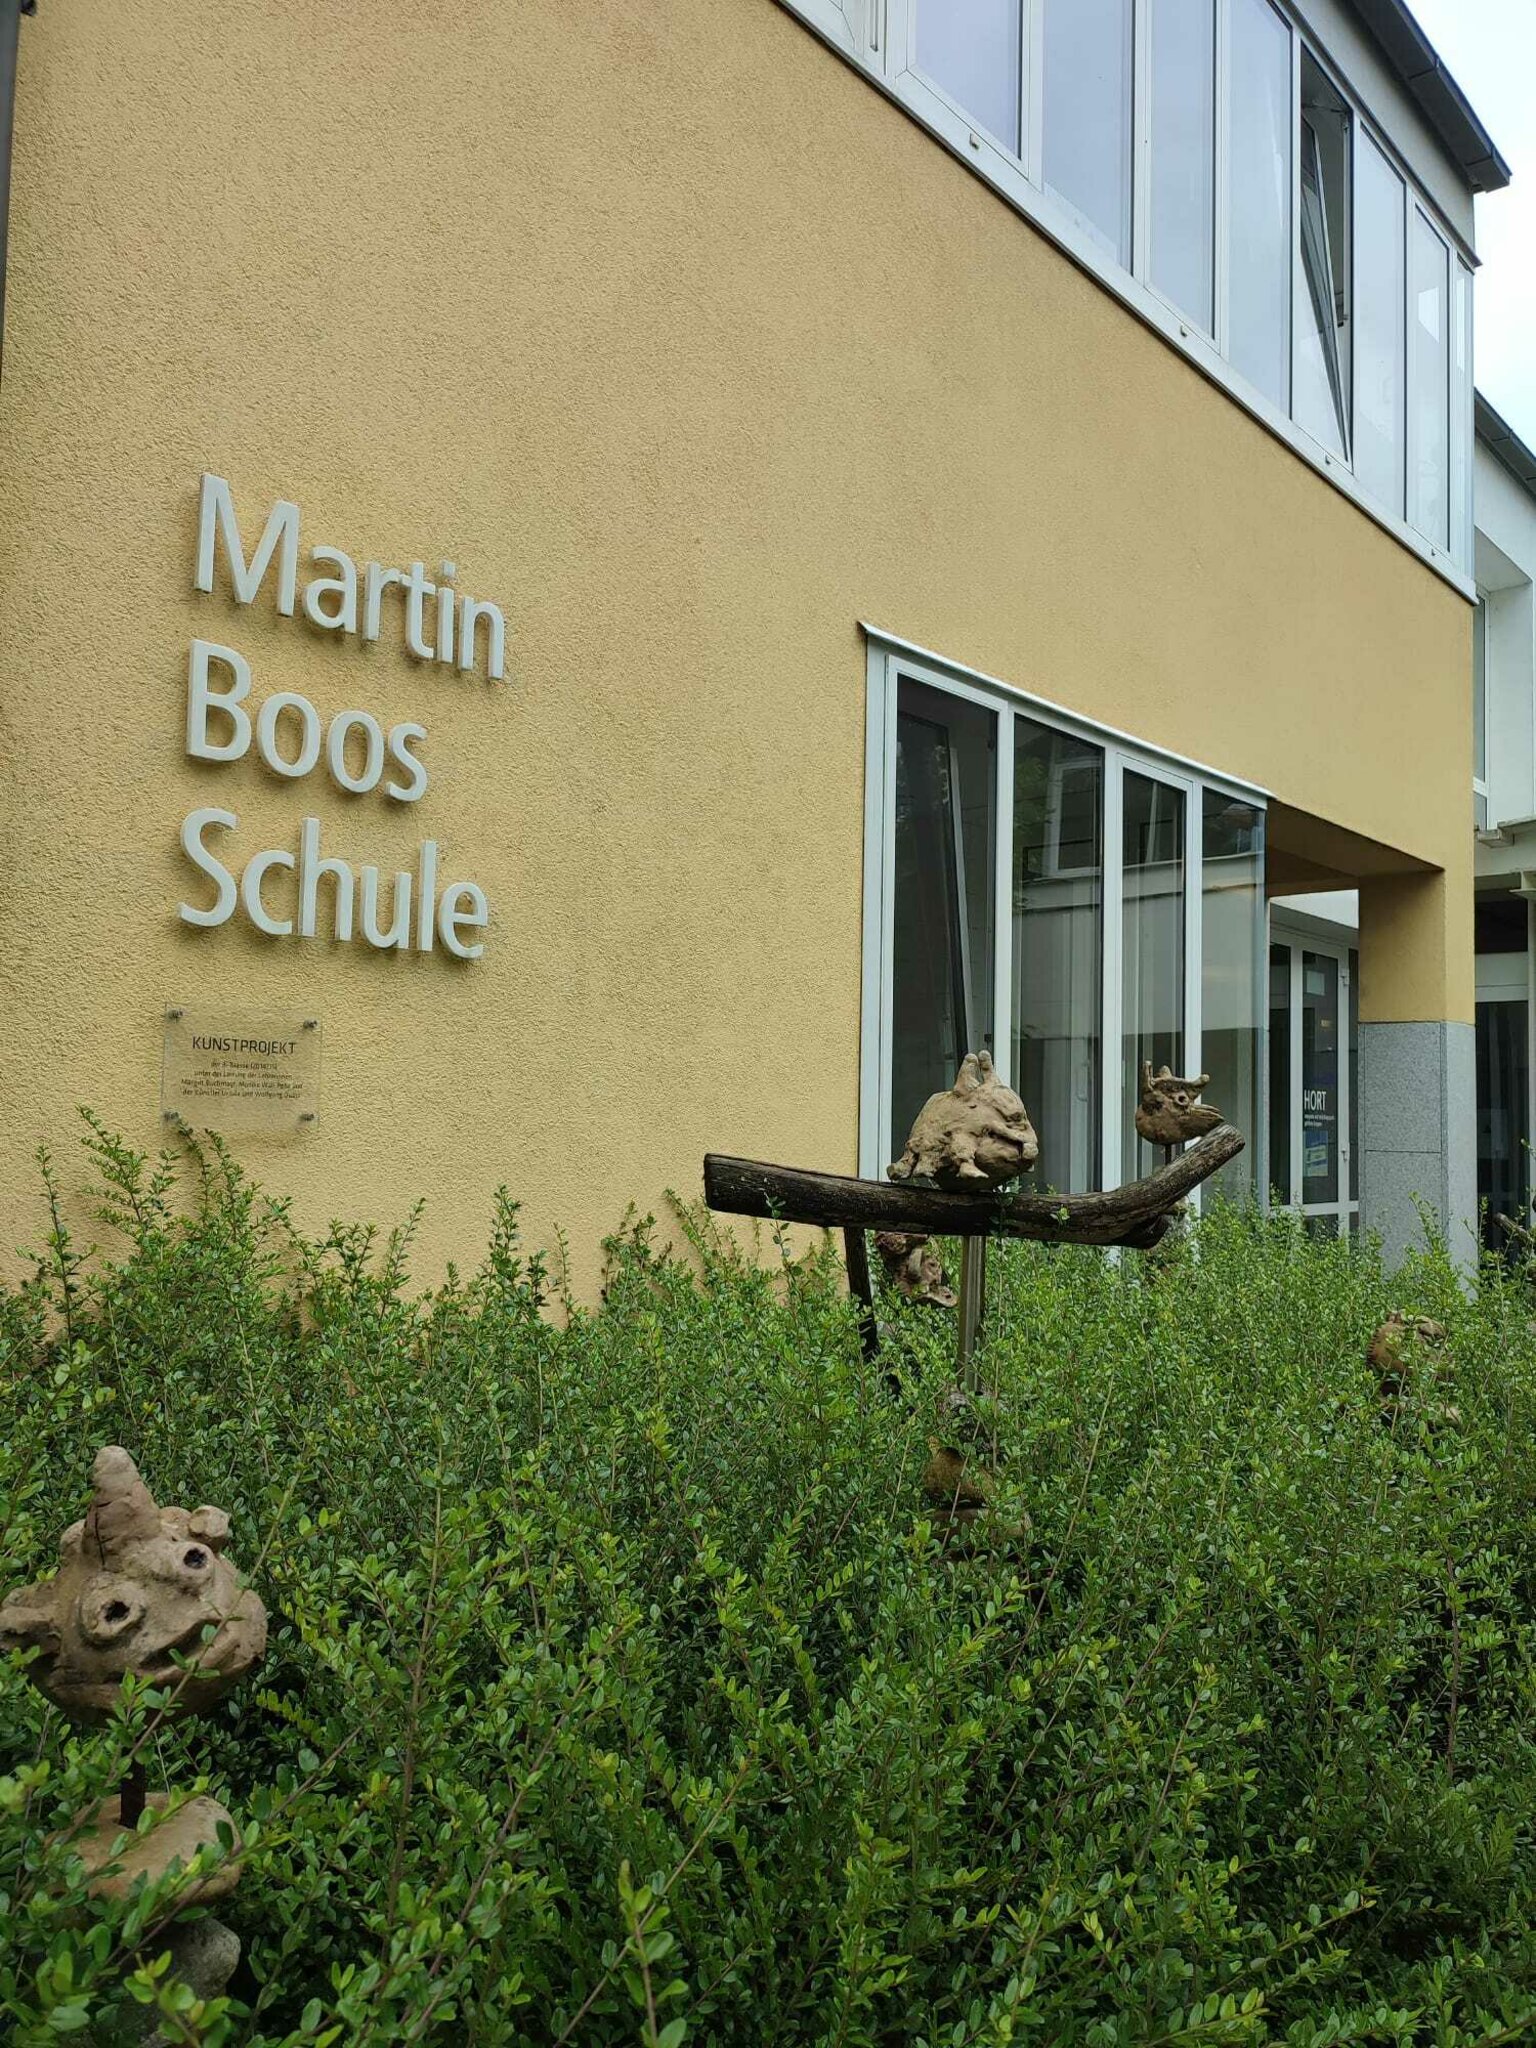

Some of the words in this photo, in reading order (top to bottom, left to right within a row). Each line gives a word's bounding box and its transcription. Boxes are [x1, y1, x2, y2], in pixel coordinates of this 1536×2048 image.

[194, 473, 506, 680] Martin
[186, 639, 429, 803] Boos
[176, 807, 489, 961] Schule
[192, 1036, 297, 1056] KUNSTPROJEKT
[1304, 1089, 1327, 1111] HORT
